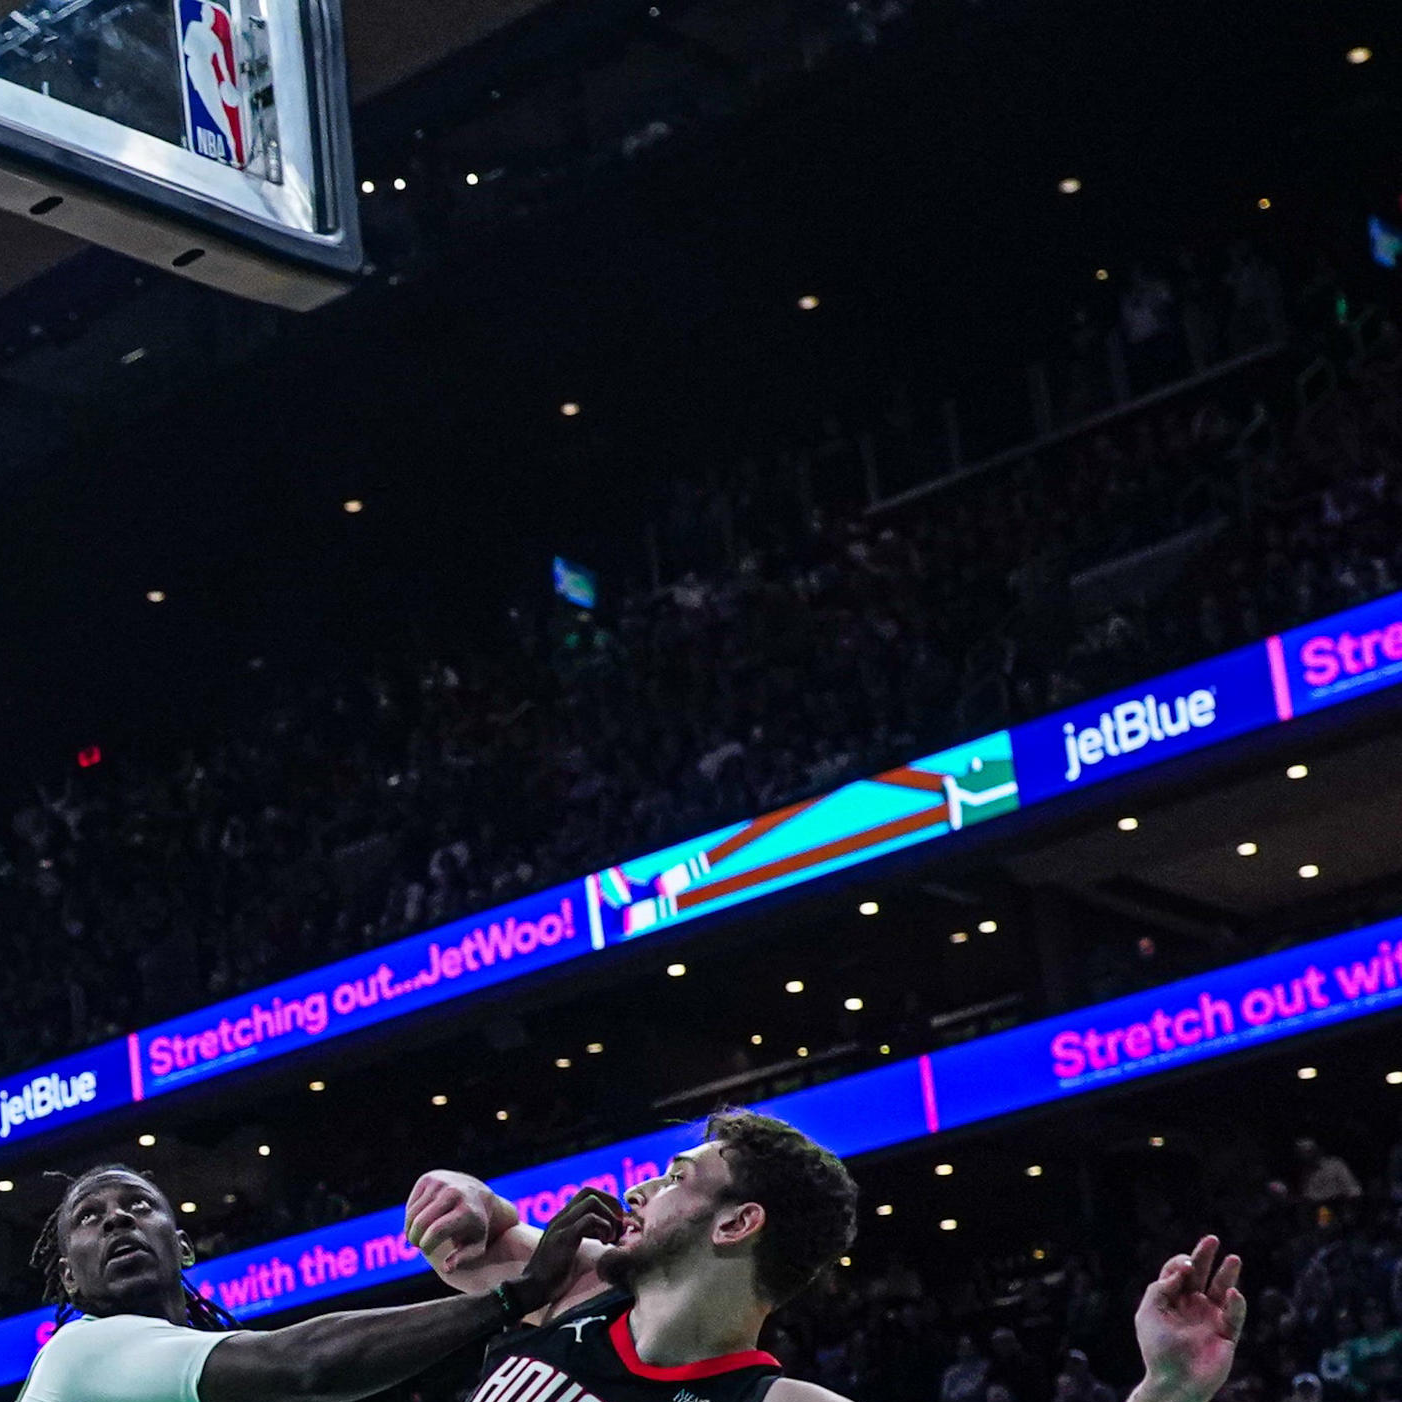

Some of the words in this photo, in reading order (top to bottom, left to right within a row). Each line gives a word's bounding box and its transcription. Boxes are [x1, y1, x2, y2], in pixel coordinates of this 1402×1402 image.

[197, 126, 227, 160] NBA
[1065, 688, 1218, 782] jetBlue
[149, 991, 328, 1076] Stretching
[1051, 992, 1234, 1078] Stretch
[1241, 965, 1329, 1026] out
[220, 1258, 296, 1308] with
[299, 1238, 360, 1281] the
